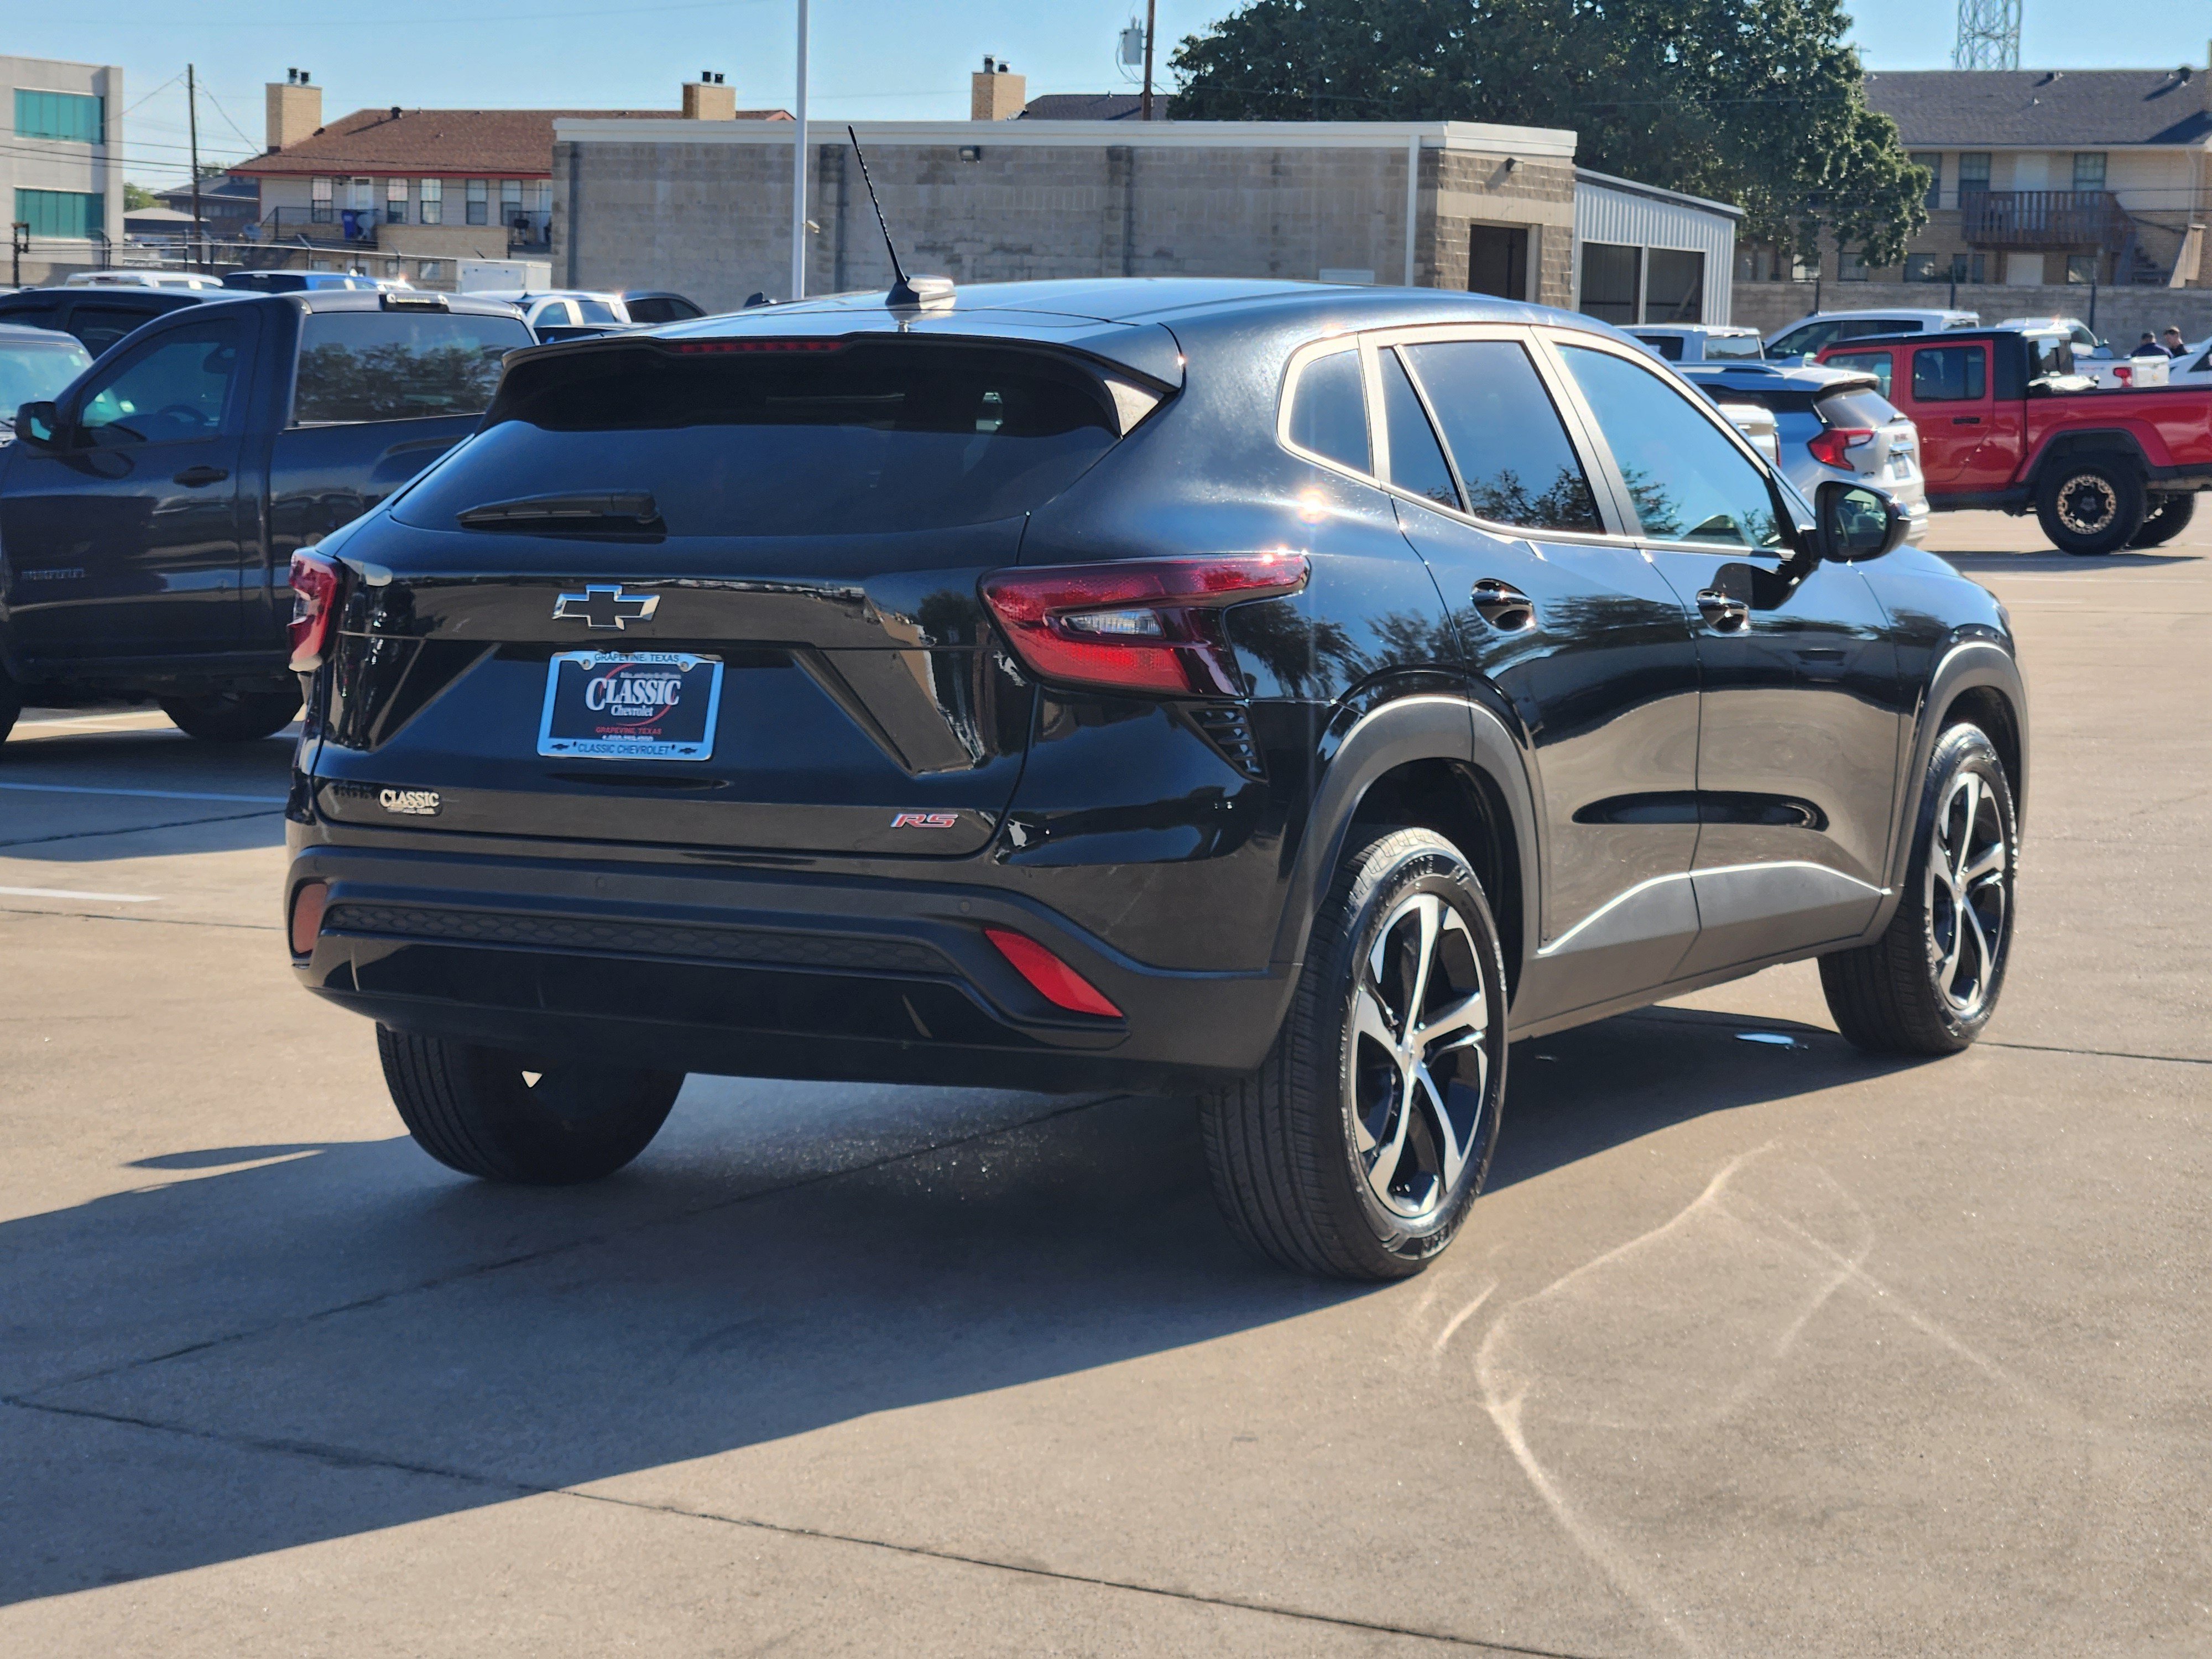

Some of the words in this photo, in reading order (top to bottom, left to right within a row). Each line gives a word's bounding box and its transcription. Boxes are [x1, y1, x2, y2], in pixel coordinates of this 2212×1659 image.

[650, 654, 680, 662] TEXAS
[586, 677, 681, 711] CLASSIC
[611, 704, 654, 717] Chevrolet
[578, 743, 615, 754] CLASSIC
[617, 744, 670, 755] CHEVROLET
[380, 789, 440, 808] CLASSIC
[890, 813, 959, 828] RS
